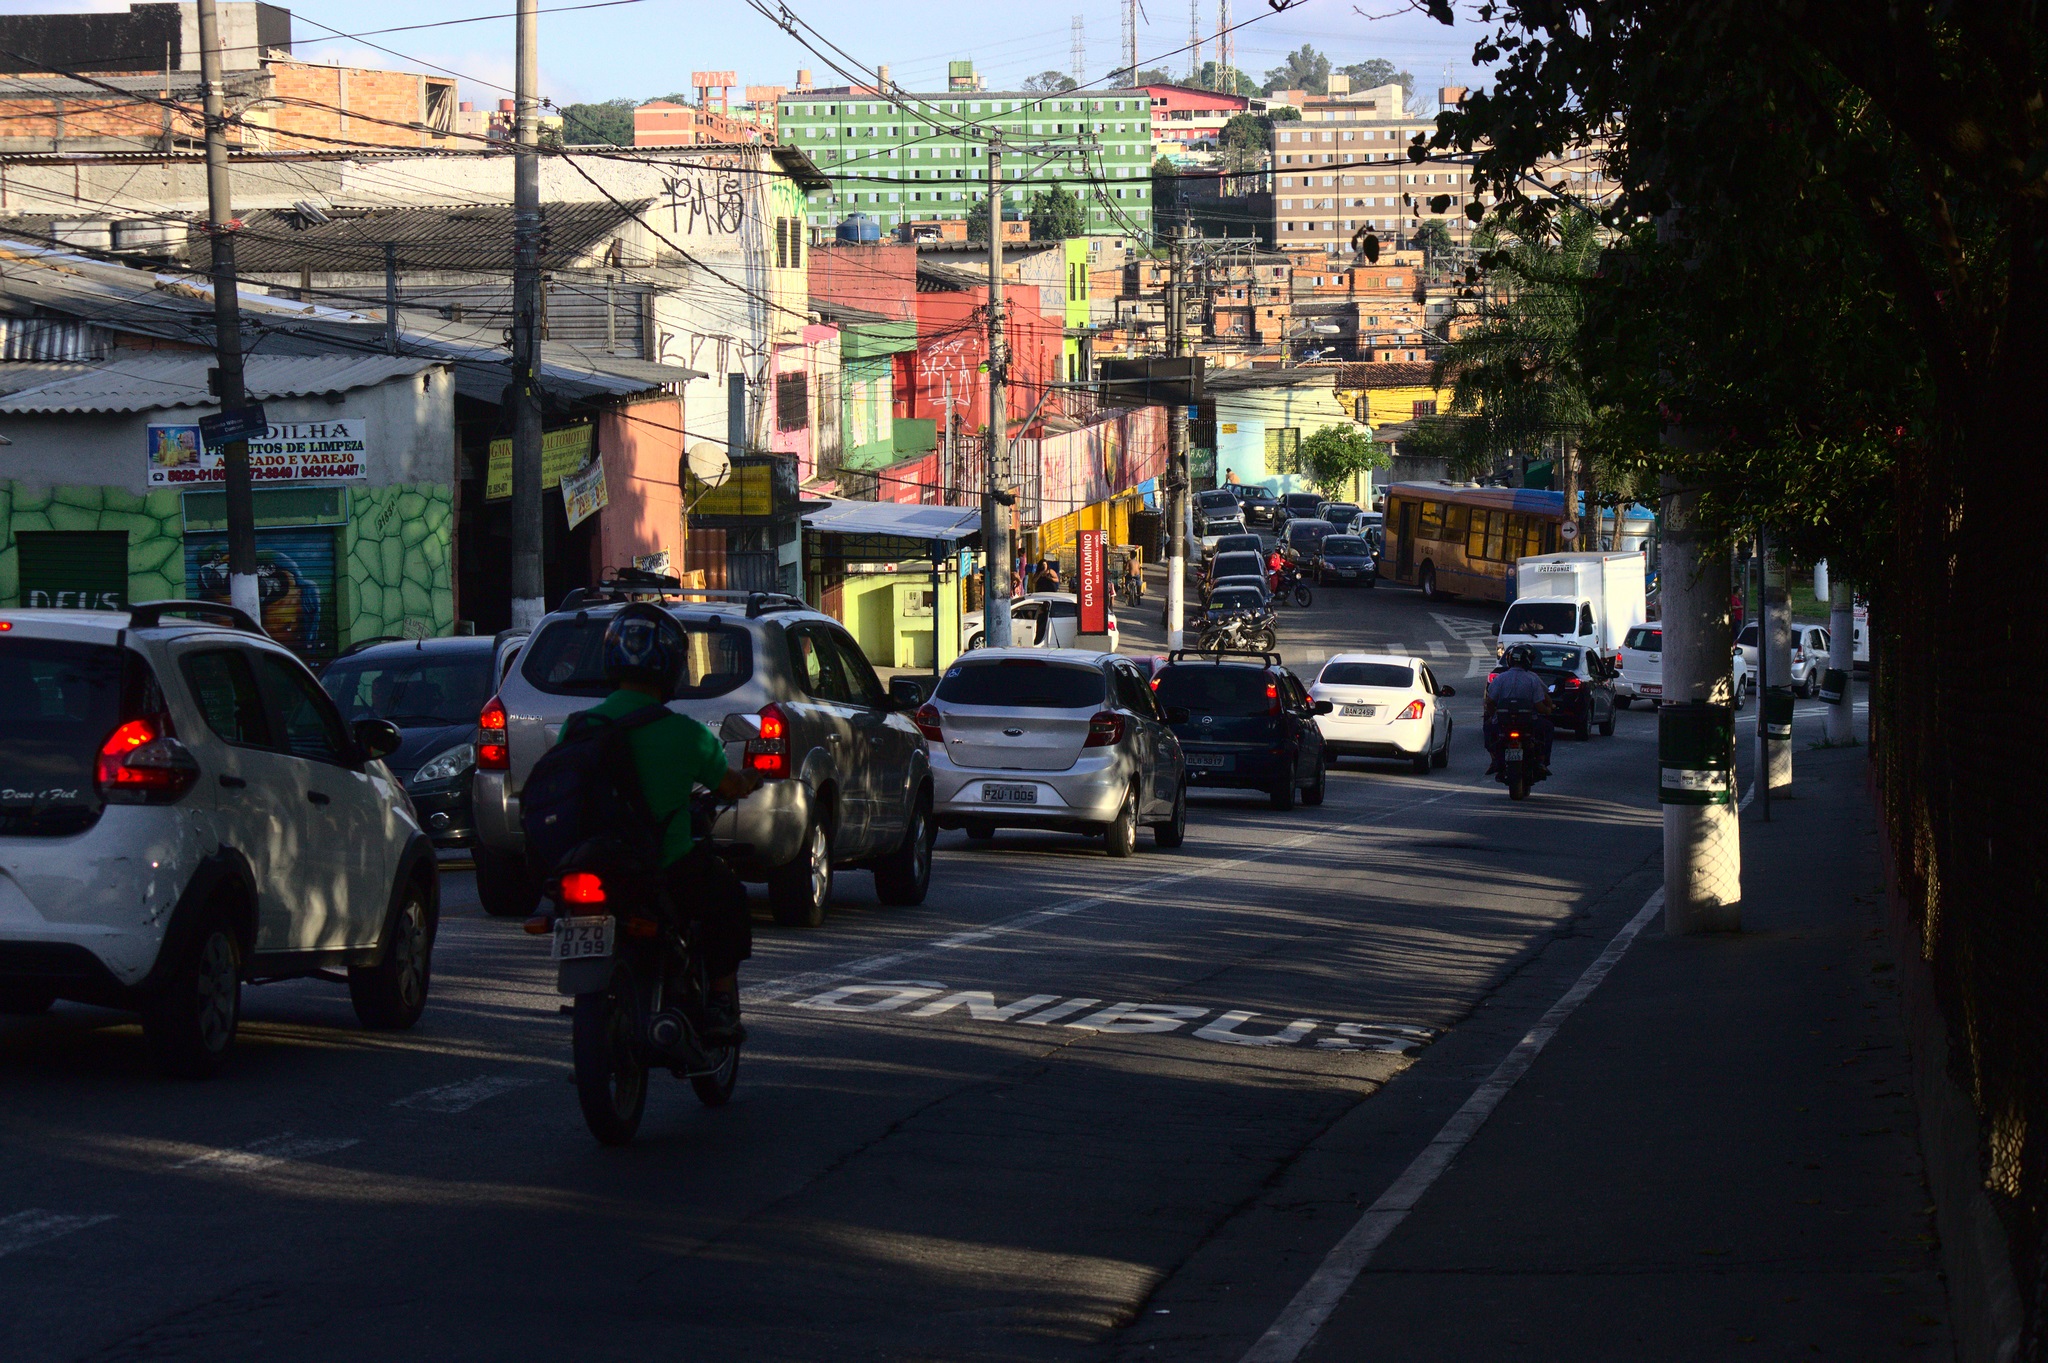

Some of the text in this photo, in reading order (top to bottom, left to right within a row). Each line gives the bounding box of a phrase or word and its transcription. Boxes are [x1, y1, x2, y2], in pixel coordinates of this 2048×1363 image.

[205, 440, 365, 456] PRUTOS DE LIMPEZA
[292, 455, 299, 465] E
[302, 453, 355, 464] VAREJO
[1082, 533, 1093, 607] CIA DO ALUMÍNIO
[1, 788, 34, 800] Deus
[49, 788, 78, 800] Fiel
[561, 941, 604, 957] 8199
[789, 980, 1438, 1054] ÔNIBUS
